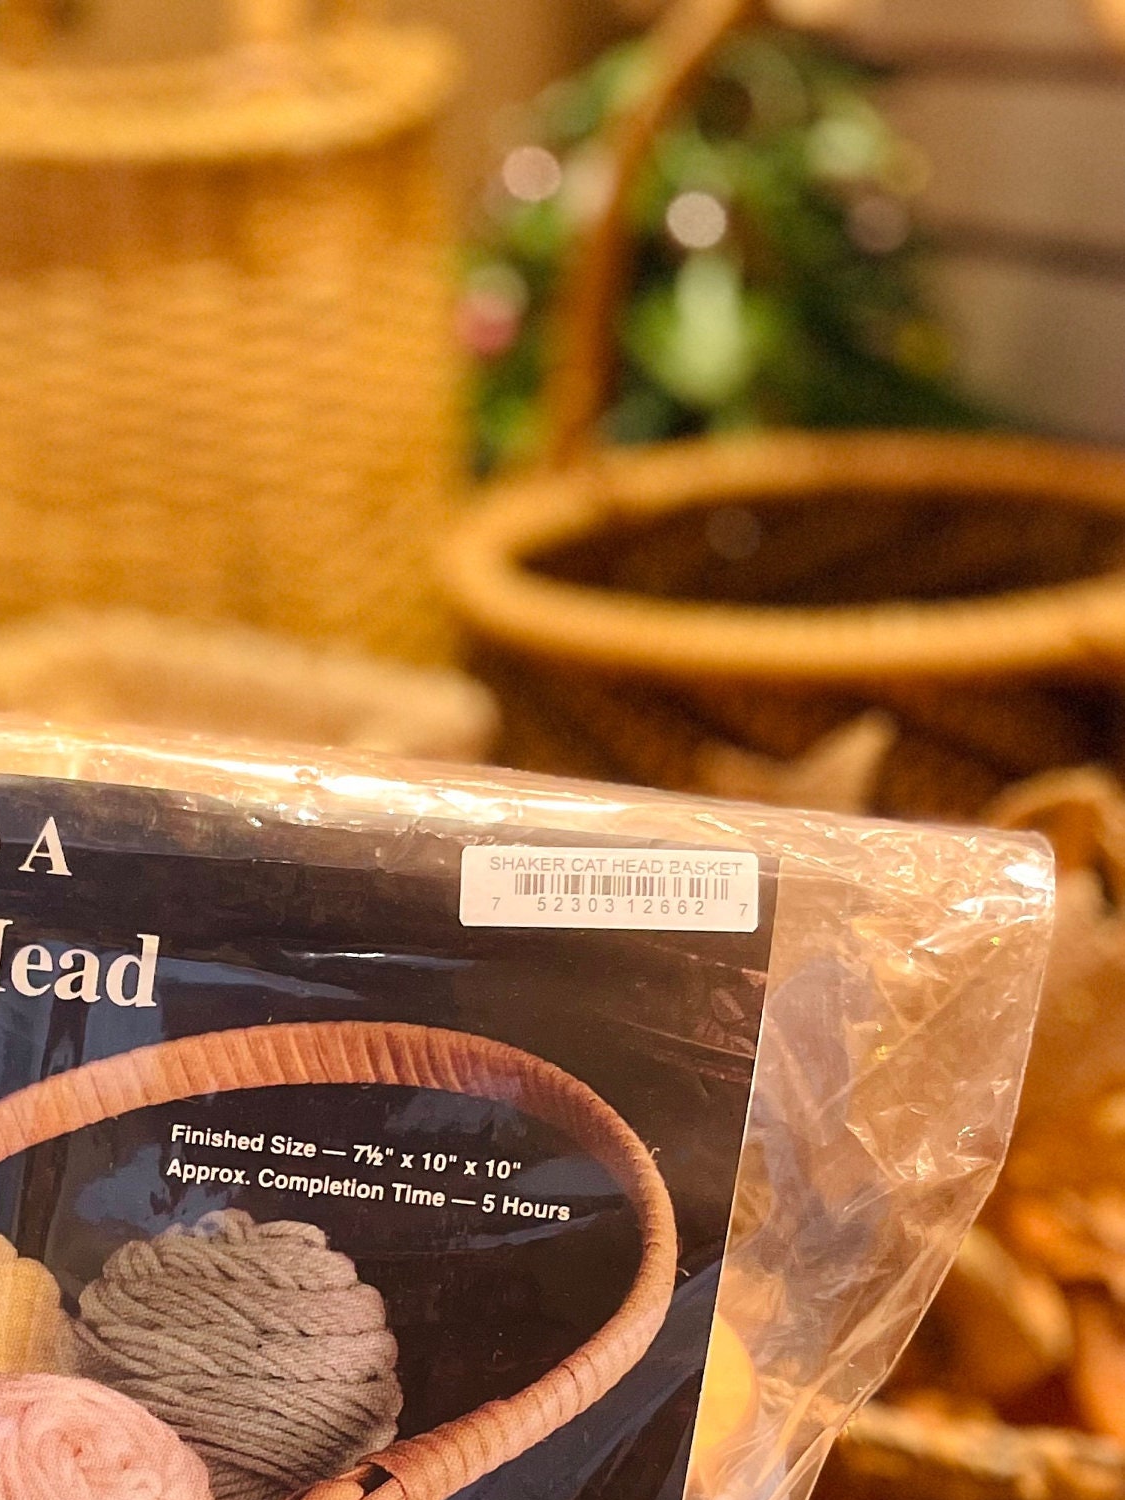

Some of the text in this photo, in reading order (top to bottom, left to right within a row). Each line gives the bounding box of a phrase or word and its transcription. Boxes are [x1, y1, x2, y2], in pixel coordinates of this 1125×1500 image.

[17, 816, 73, 876] A
[490, 856, 564, 872] SHAKER
[571, 858, 607, 873] CAT
[613, 859, 664, 874] HEAD
[171, 1124, 264, 1152] Finished
[270, 1135, 317, 1158] Size
[400, 1154, 414, 1169] x
[422, 1152, 457, 1173] 10"
[463, 1160, 477, 1176] x
[485, 1160, 522, 1180] 10"
[166, 1158, 251, 1186] Approx.
[258, 1169, 384, 1201] Completion
[393, 1183, 446, 1207] Time
[481, 1194, 495, 1212] 5
[502, 1197, 572, 1221] Hours
